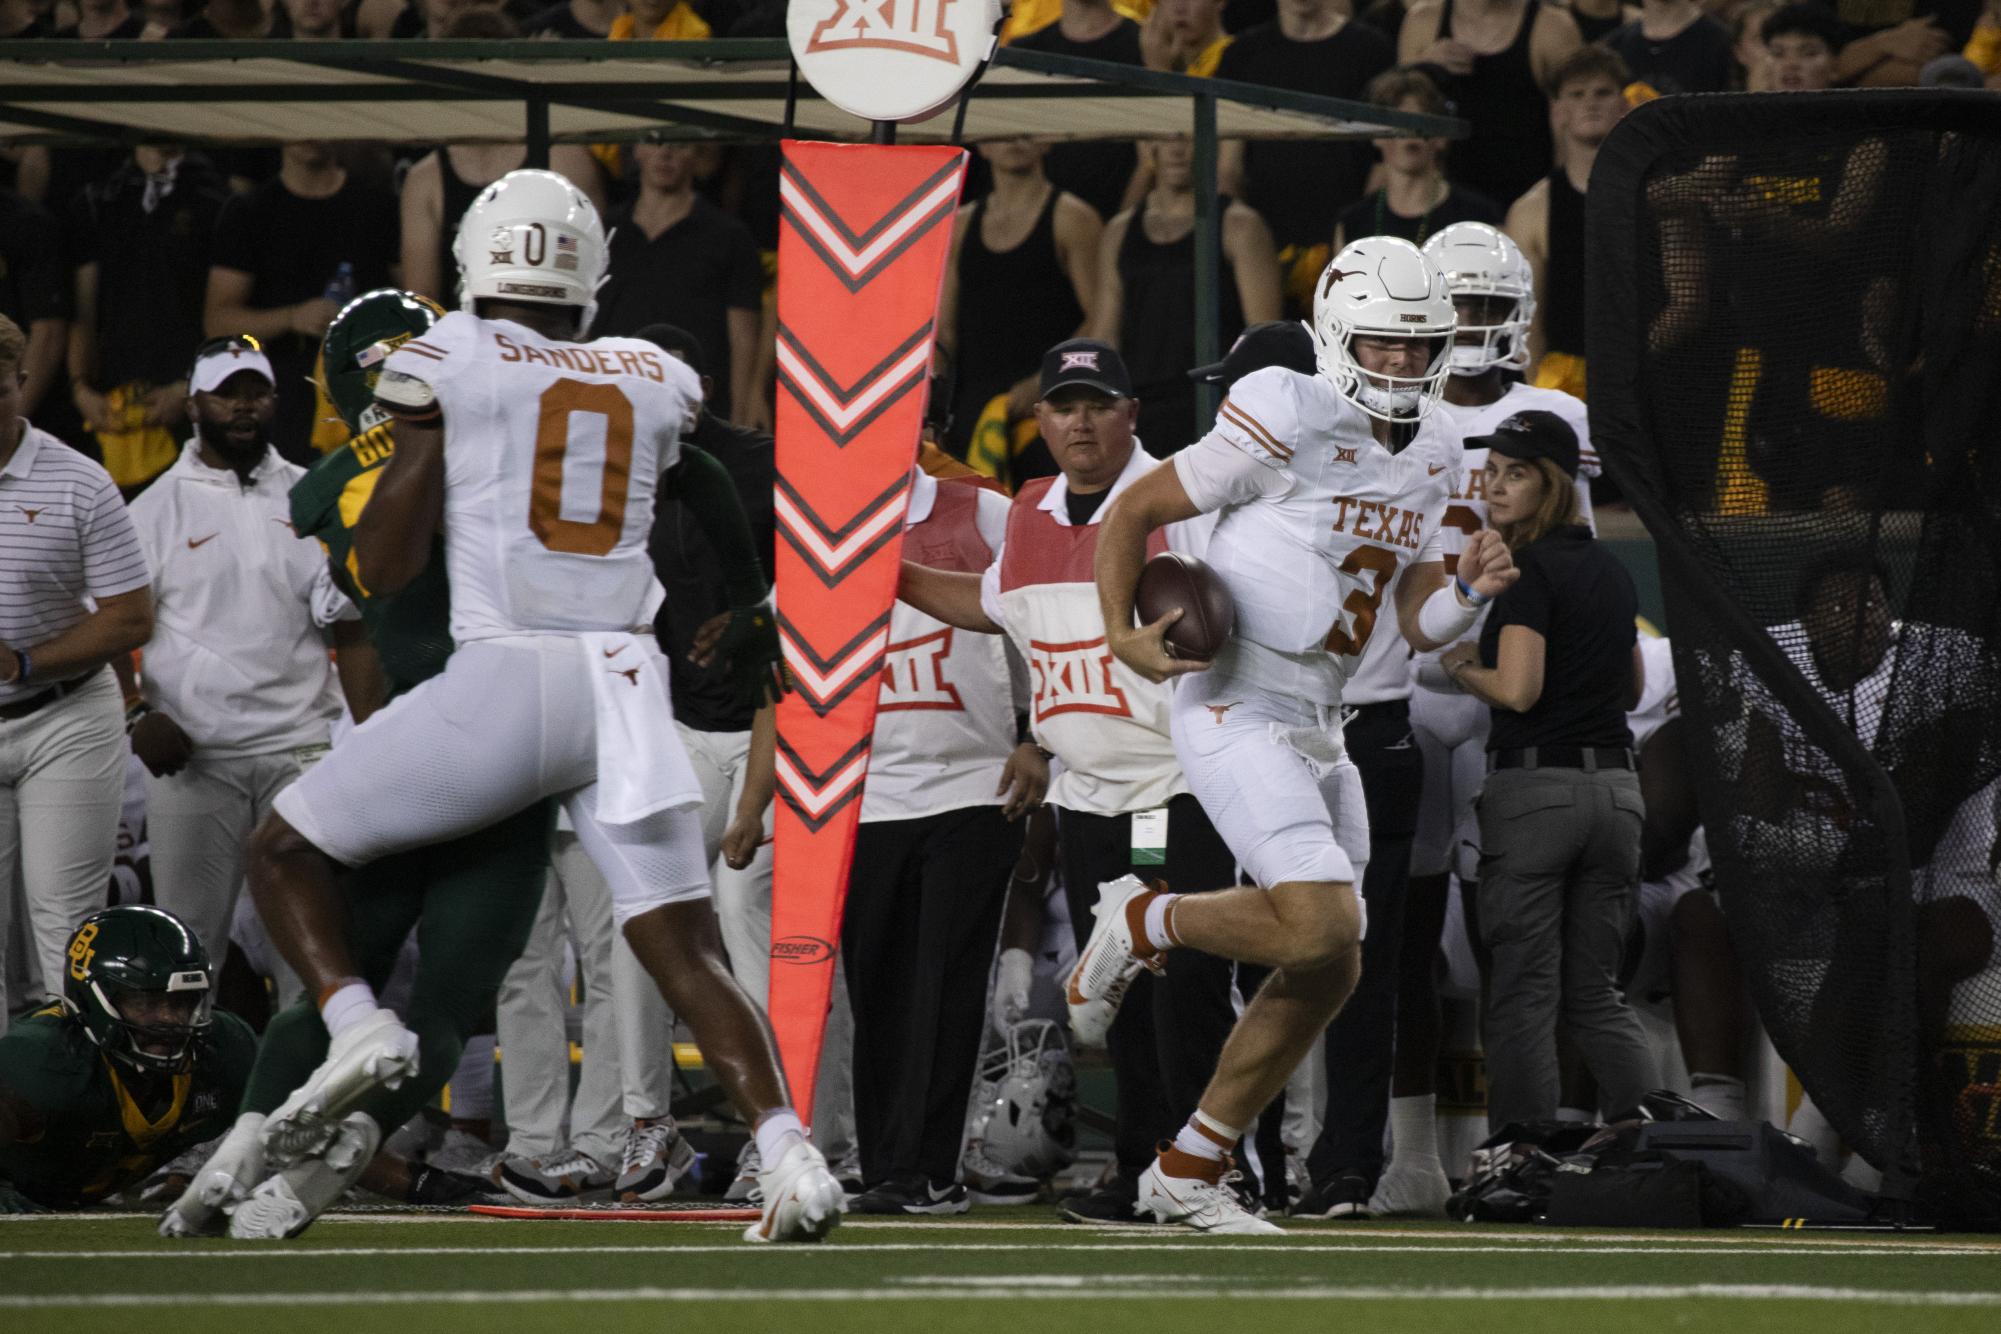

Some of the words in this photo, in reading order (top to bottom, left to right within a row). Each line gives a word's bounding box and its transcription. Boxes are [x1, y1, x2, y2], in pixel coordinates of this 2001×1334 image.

[525, 222, 546, 267] 0
[1400, 313, 1427, 323] HORNS
[494, 332, 665, 384] SANDERS
[1058, 351, 1101, 374] XII
[528, 376, 635, 558] 0
[1331, 444, 1358, 465] XII
[1331, 495, 1425, 550] TEXAS
[1323, 543, 1399, 658] 3
[1029, 636, 1134, 724] XII
[771, 942, 820, 956] FISHER
